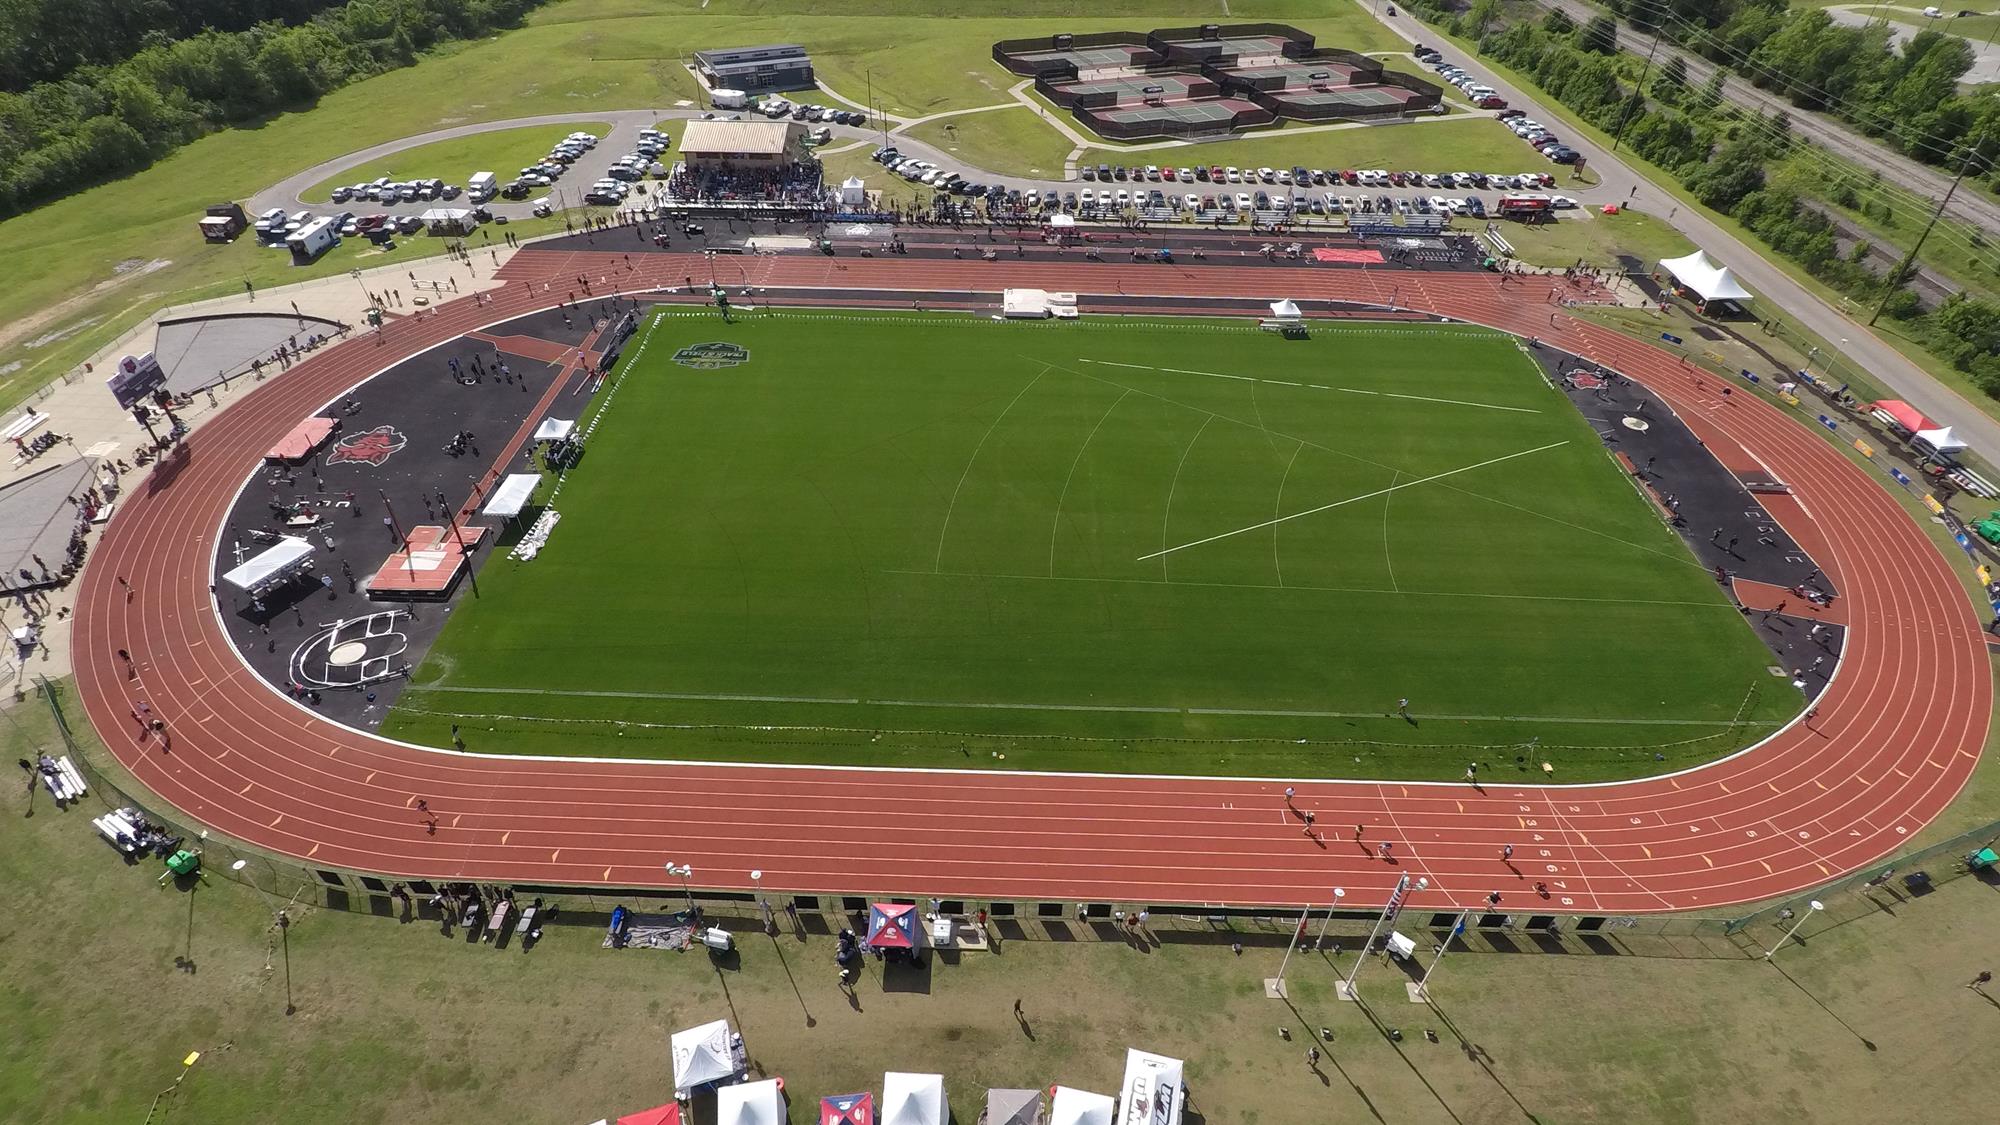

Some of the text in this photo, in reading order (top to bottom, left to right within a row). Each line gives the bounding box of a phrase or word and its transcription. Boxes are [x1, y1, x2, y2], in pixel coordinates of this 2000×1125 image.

[1526, 819, 1538, 827] 3
[1631, 817, 1642, 825] 3
[1689, 825, 1701, 833] 4
[1849, 829, 1862, 837] 7
[1895, 825, 1908, 835] 8
[1533, 833, 1545, 842] 4
[1745, 830, 1758, 838] 5
[1798, 831, 1811, 839] 6
[1539, 849, 1552, 857] 5
[1546, 864, 1559, 873] 6
[1553, 880, 1567, 889] 7
[1561, 897, 1574, 906] 8
